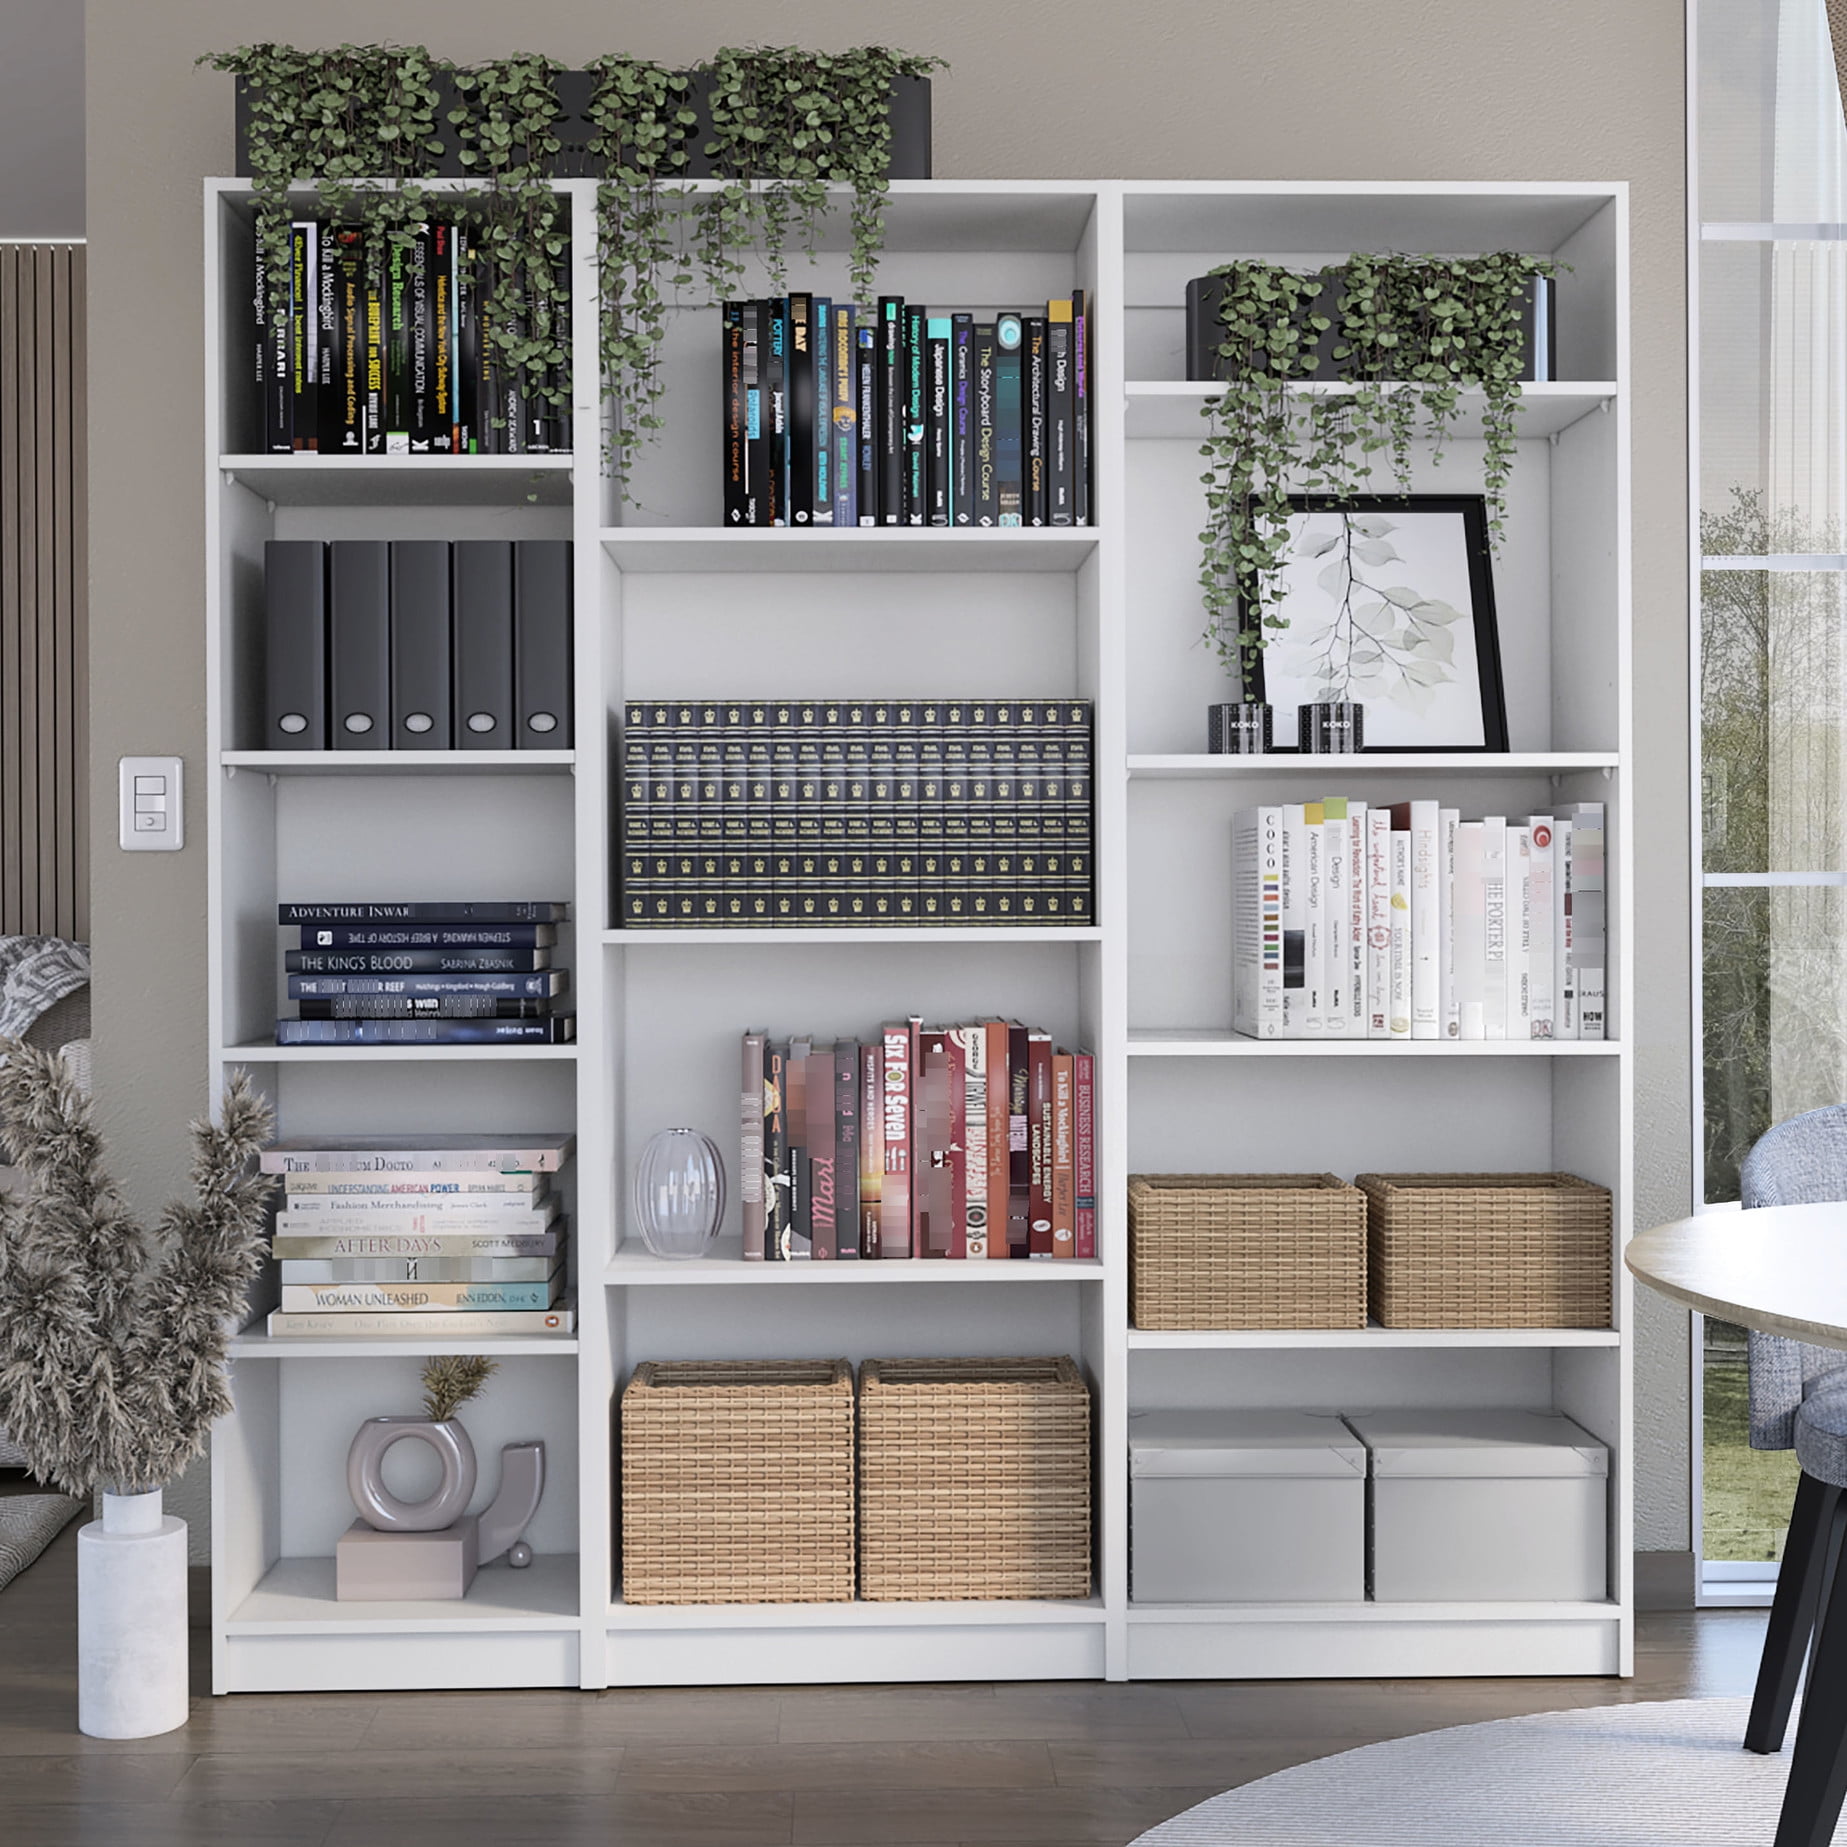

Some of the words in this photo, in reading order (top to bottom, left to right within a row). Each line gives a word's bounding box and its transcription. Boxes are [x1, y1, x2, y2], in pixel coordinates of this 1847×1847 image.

[322, 235, 333, 247] To
[253, 264, 265, 326] Mockingbird
[319, 272, 334, 330] Mockingbird
[391, 281, 404, 330] Research
[277, 309, 286, 378] FRRARI
[731, 328, 741, 348] the
[795, 326, 806, 353] DAY
[910, 315, 920, 345] History
[1032, 336, 1042, 355] The
[414, 328, 425, 394] COMMUNICATION
[731, 350, 741, 395] interior
[912, 356, 920, 389] Modern
[934, 343, 945, 386] Japanese
[958, 345, 967, 380] Ceramics
[981, 346, 992, 367] The
[368, 359, 381, 390] SUCCESS
[1032, 355, 1042, 415] Architectural
[1054, 359, 1068, 392] Design
[910, 389, 921, 419] Design
[933, 386, 945, 417] Design
[956, 380, 967, 406] Design
[978, 367, 992, 426] Storyboard
[345, 396, 356, 425] Coding
[730, 397, 743, 439] design
[958, 407, 967, 435] Course
[979, 427, 992, 462] Design
[1030, 416, 1043, 457] Drawing
[731, 441, 741, 482] course
[1032, 457, 1043, 493] Course
[981, 464, 992, 501] Course
[1310, 832, 1320, 875] American
[1330, 857, 1342, 889] Design
[1307, 876, 1320, 909] Design
[1487, 901, 1504, 951] PORTER
[301, 955, 323, 971] THE
[326, 955, 366, 972] KING'S
[370, 955, 414, 971] BLOOD
[300, 982, 317, 994] THE
[866, 1084, 875, 1101] AND
[1079, 1083, 1092, 1135] BUSINESS
[1043, 1102, 1052, 1165] SUSTAINABLE
[1057, 1107, 1069, 1164] Mockingbird
[284, 1156, 310, 1172] THE
[1032, 1123, 1042, 1186] LANDSCAPES
[1079, 1135, 1092, 1194] RESEARCH
[328, 1183, 390, 1194] UNDERSTANDING
[390, 1183, 429, 1193] AMERICAN
[430, 1183, 460, 1193] POWER
[1043, 1166, 1052, 1204] ENERGY
[330, 1200, 368, 1210] Fashion
[373, 1200, 444, 1213] Merchandising
[334, 1239, 390, 1253] AFTER
[396, 1238, 442, 1252] DAYS
[472, 1240, 500, 1249] SCOTT
[315, 1292, 364, 1306] WOMAN
[364, 1292, 429, 1306] UNLEASHED
